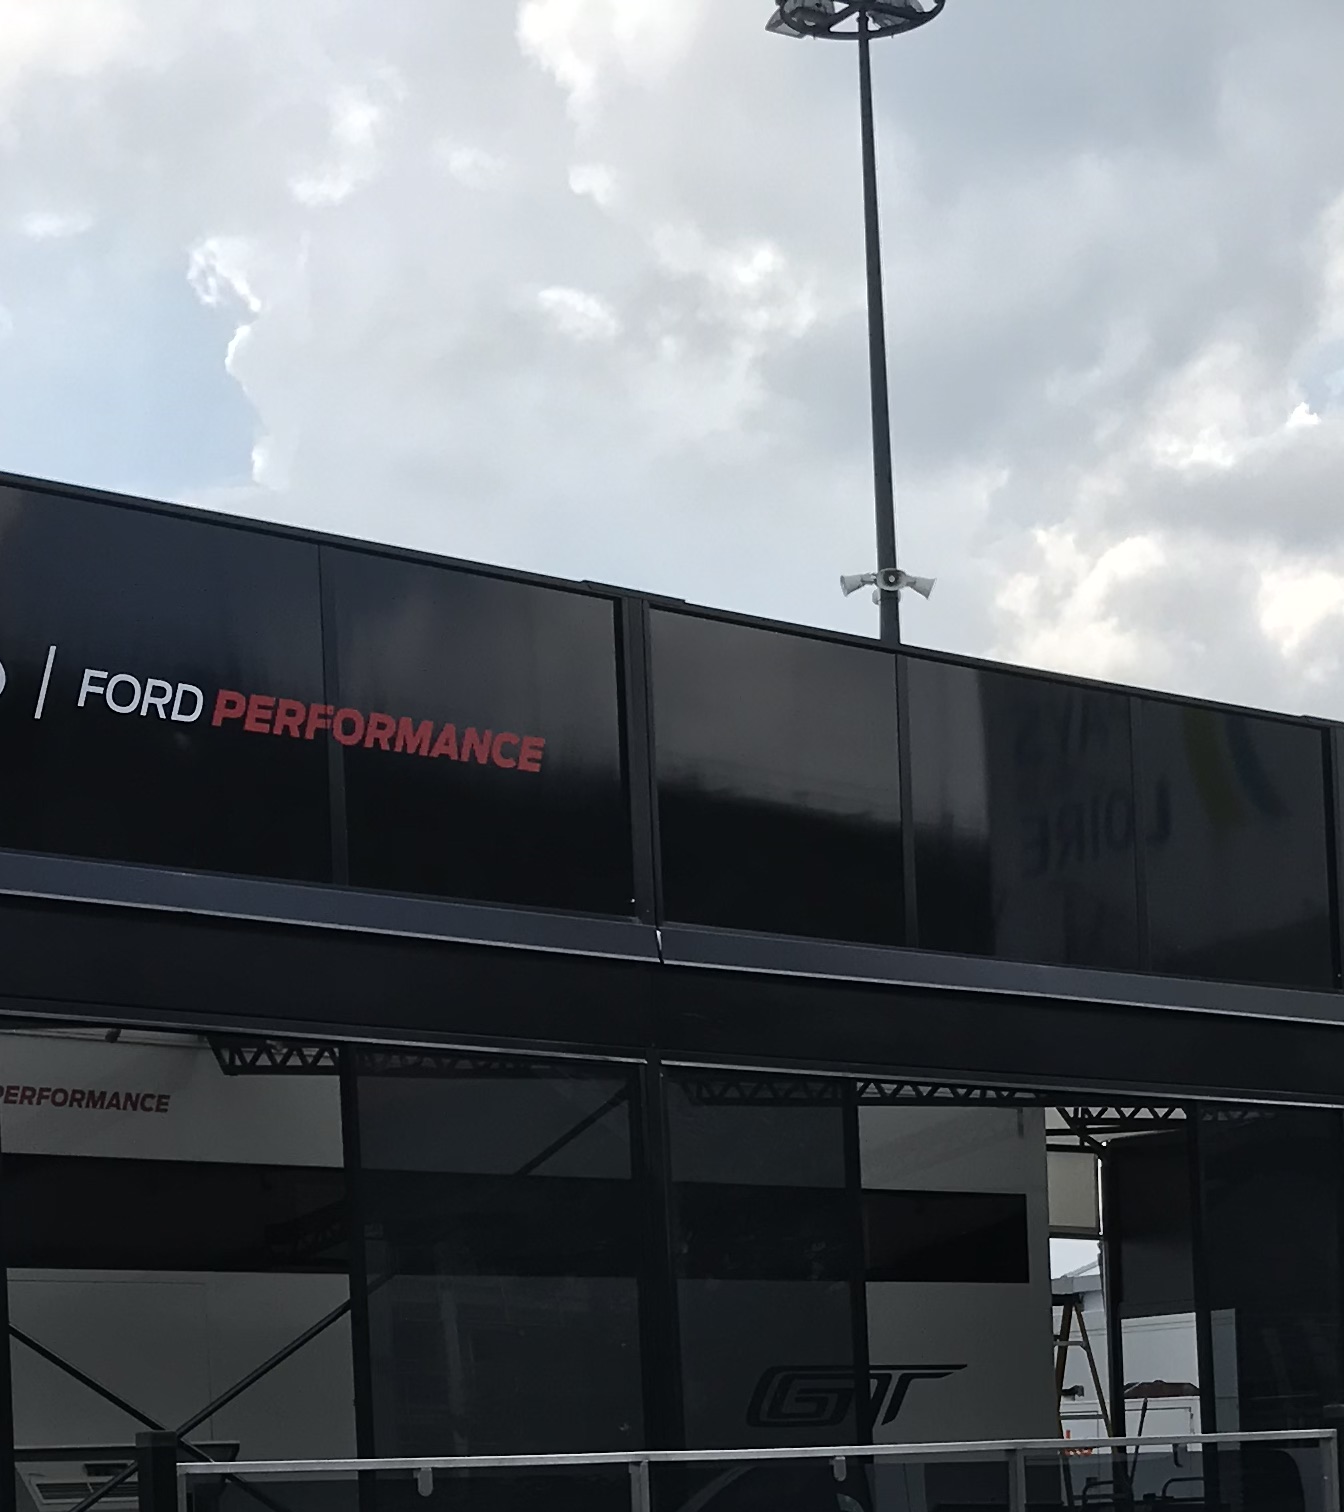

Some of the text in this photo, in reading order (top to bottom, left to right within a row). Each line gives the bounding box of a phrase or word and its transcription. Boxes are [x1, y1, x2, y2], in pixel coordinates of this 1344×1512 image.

[77, 669, 546, 774] FORD PERFORMANCE
[746, 1364, 968, 1428] GT
